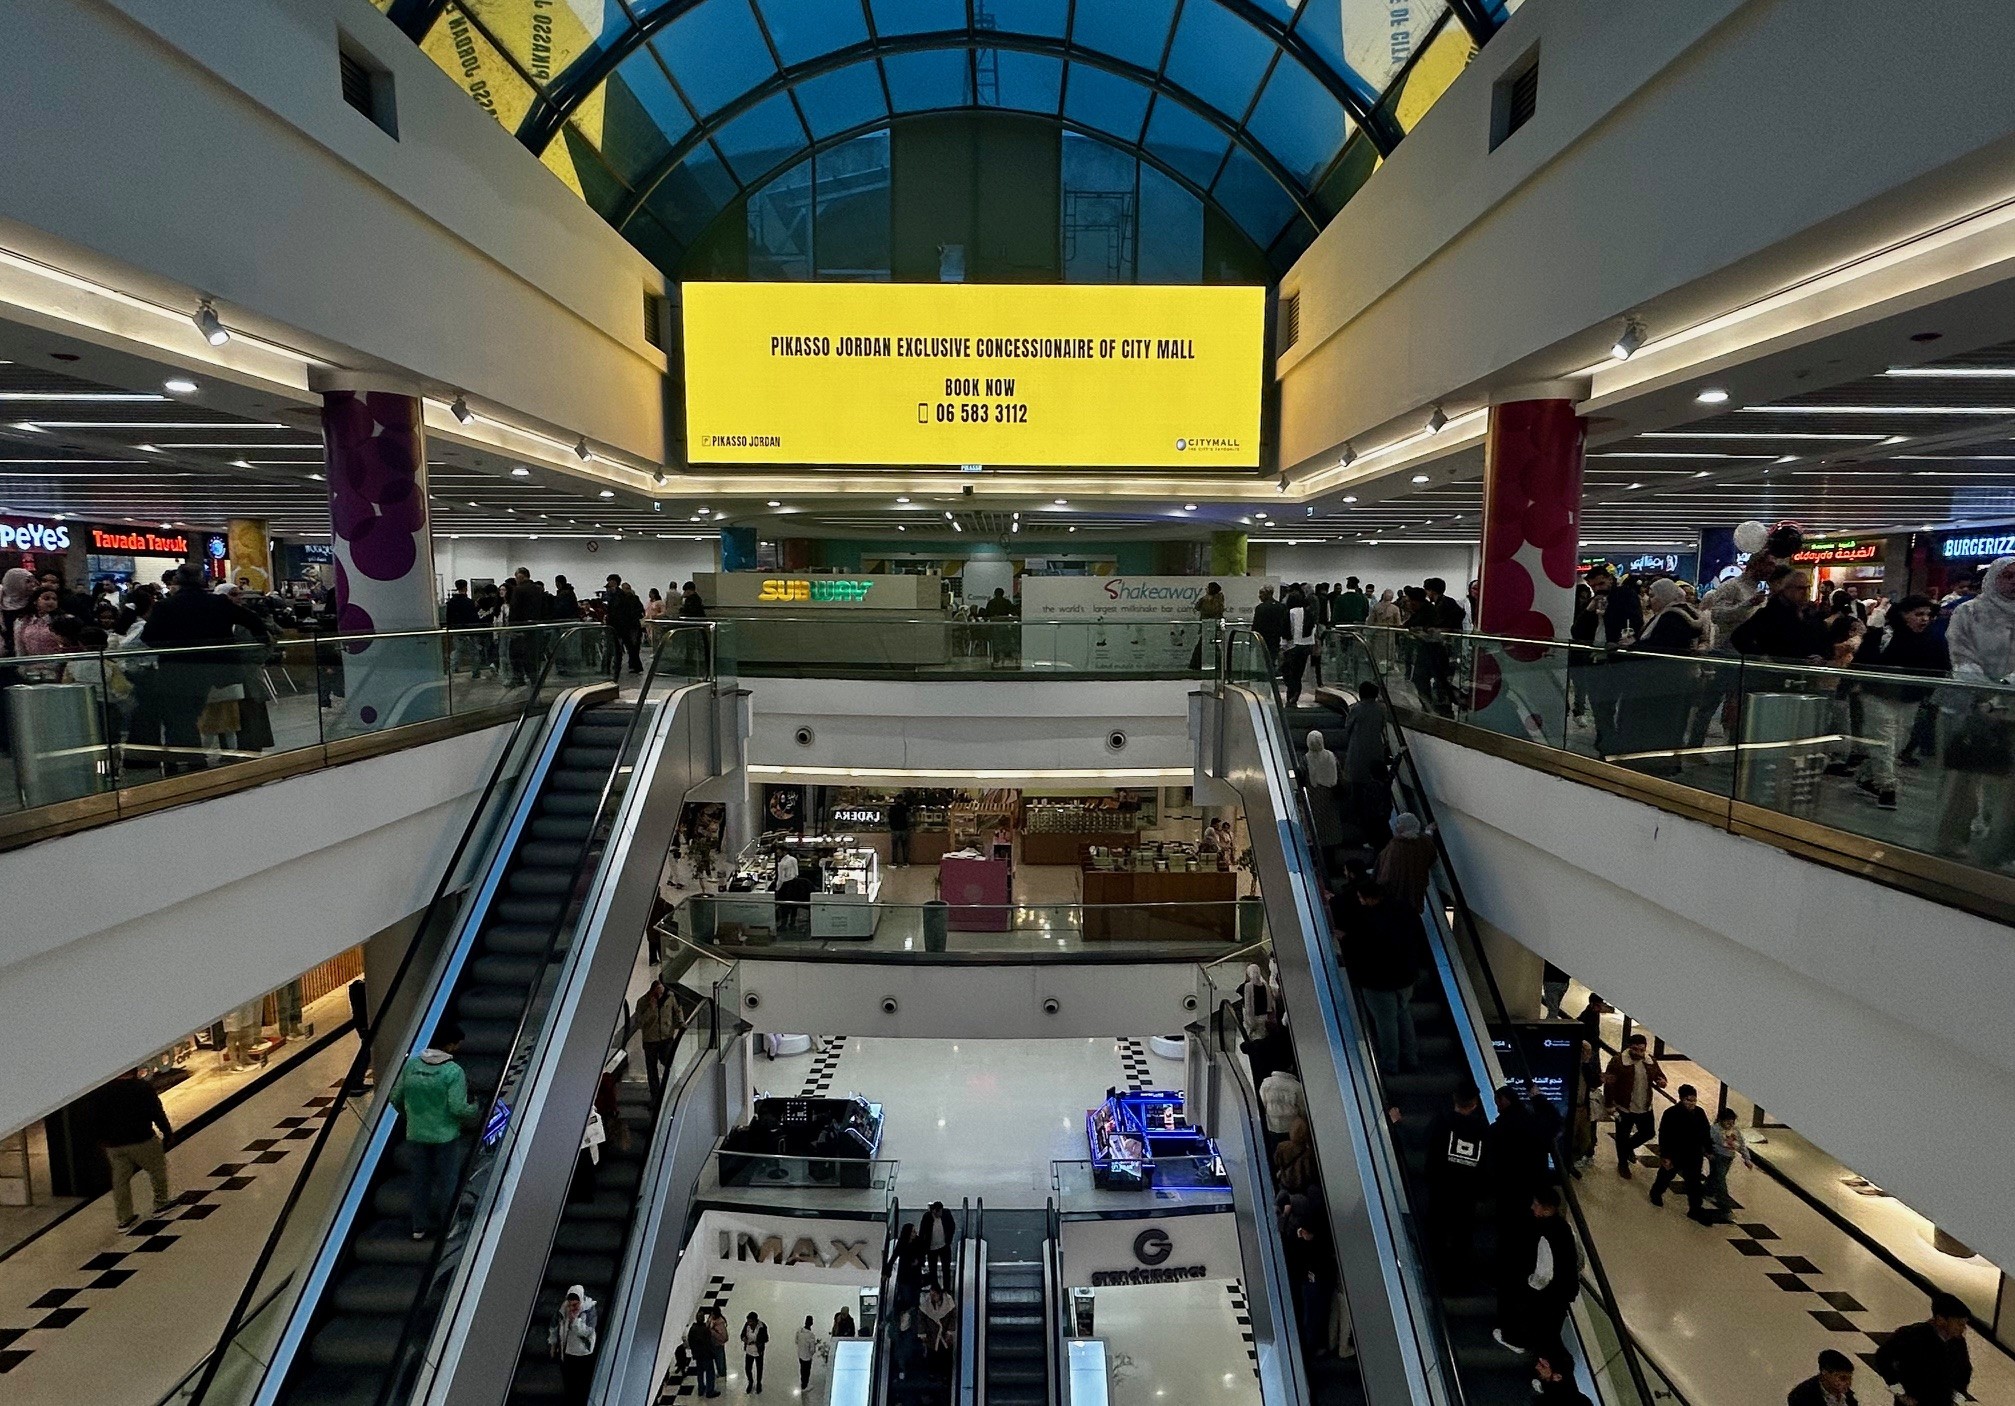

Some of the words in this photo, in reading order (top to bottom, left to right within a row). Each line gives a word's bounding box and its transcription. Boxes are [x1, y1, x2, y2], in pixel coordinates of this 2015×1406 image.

[772, 336, 830, 357] PIKASSO
[836, 336, 891, 357] JORDAN
[897, 337, 971, 358] EXCLUSIVE
[976, 338, 1094, 358] CONCESSIONAIRE
[1099, 339, 1116, 358] OF
[1121, 339, 1152, 359] CITY
[1157, 339, 1195, 359] MALL
[945, 378, 980, 397] BOOK
[985, 378, 1015, 397] NOW
[936, 403, 955, 423] 06
[960, 403, 989, 423] 583
[995, 403, 1028, 423] 3112
[712, 435, 747, 447] PIKASSO
[749, 436, 781, 448] JORDAN
[1188, 438, 1240, 447] CITYMALL
[92, 529, 146, 550] Tavada
[145, 534, 188, 553] Tavuk
[758, 579, 874, 602] SUBWAY
[1104, 578, 1204, 605] Shakeaway
[1042, 604, 1055, 613] the
[1059, 604, 1085, 613] world's
[1092, 604, 1117, 615] largest
[1121, 604, 1158, 613] milkshake
[1161, 605, 1174, 613] bar
[718, 1229, 870, 1271] IMAX
[1091, 1265, 1207, 1287] grandcinemas
